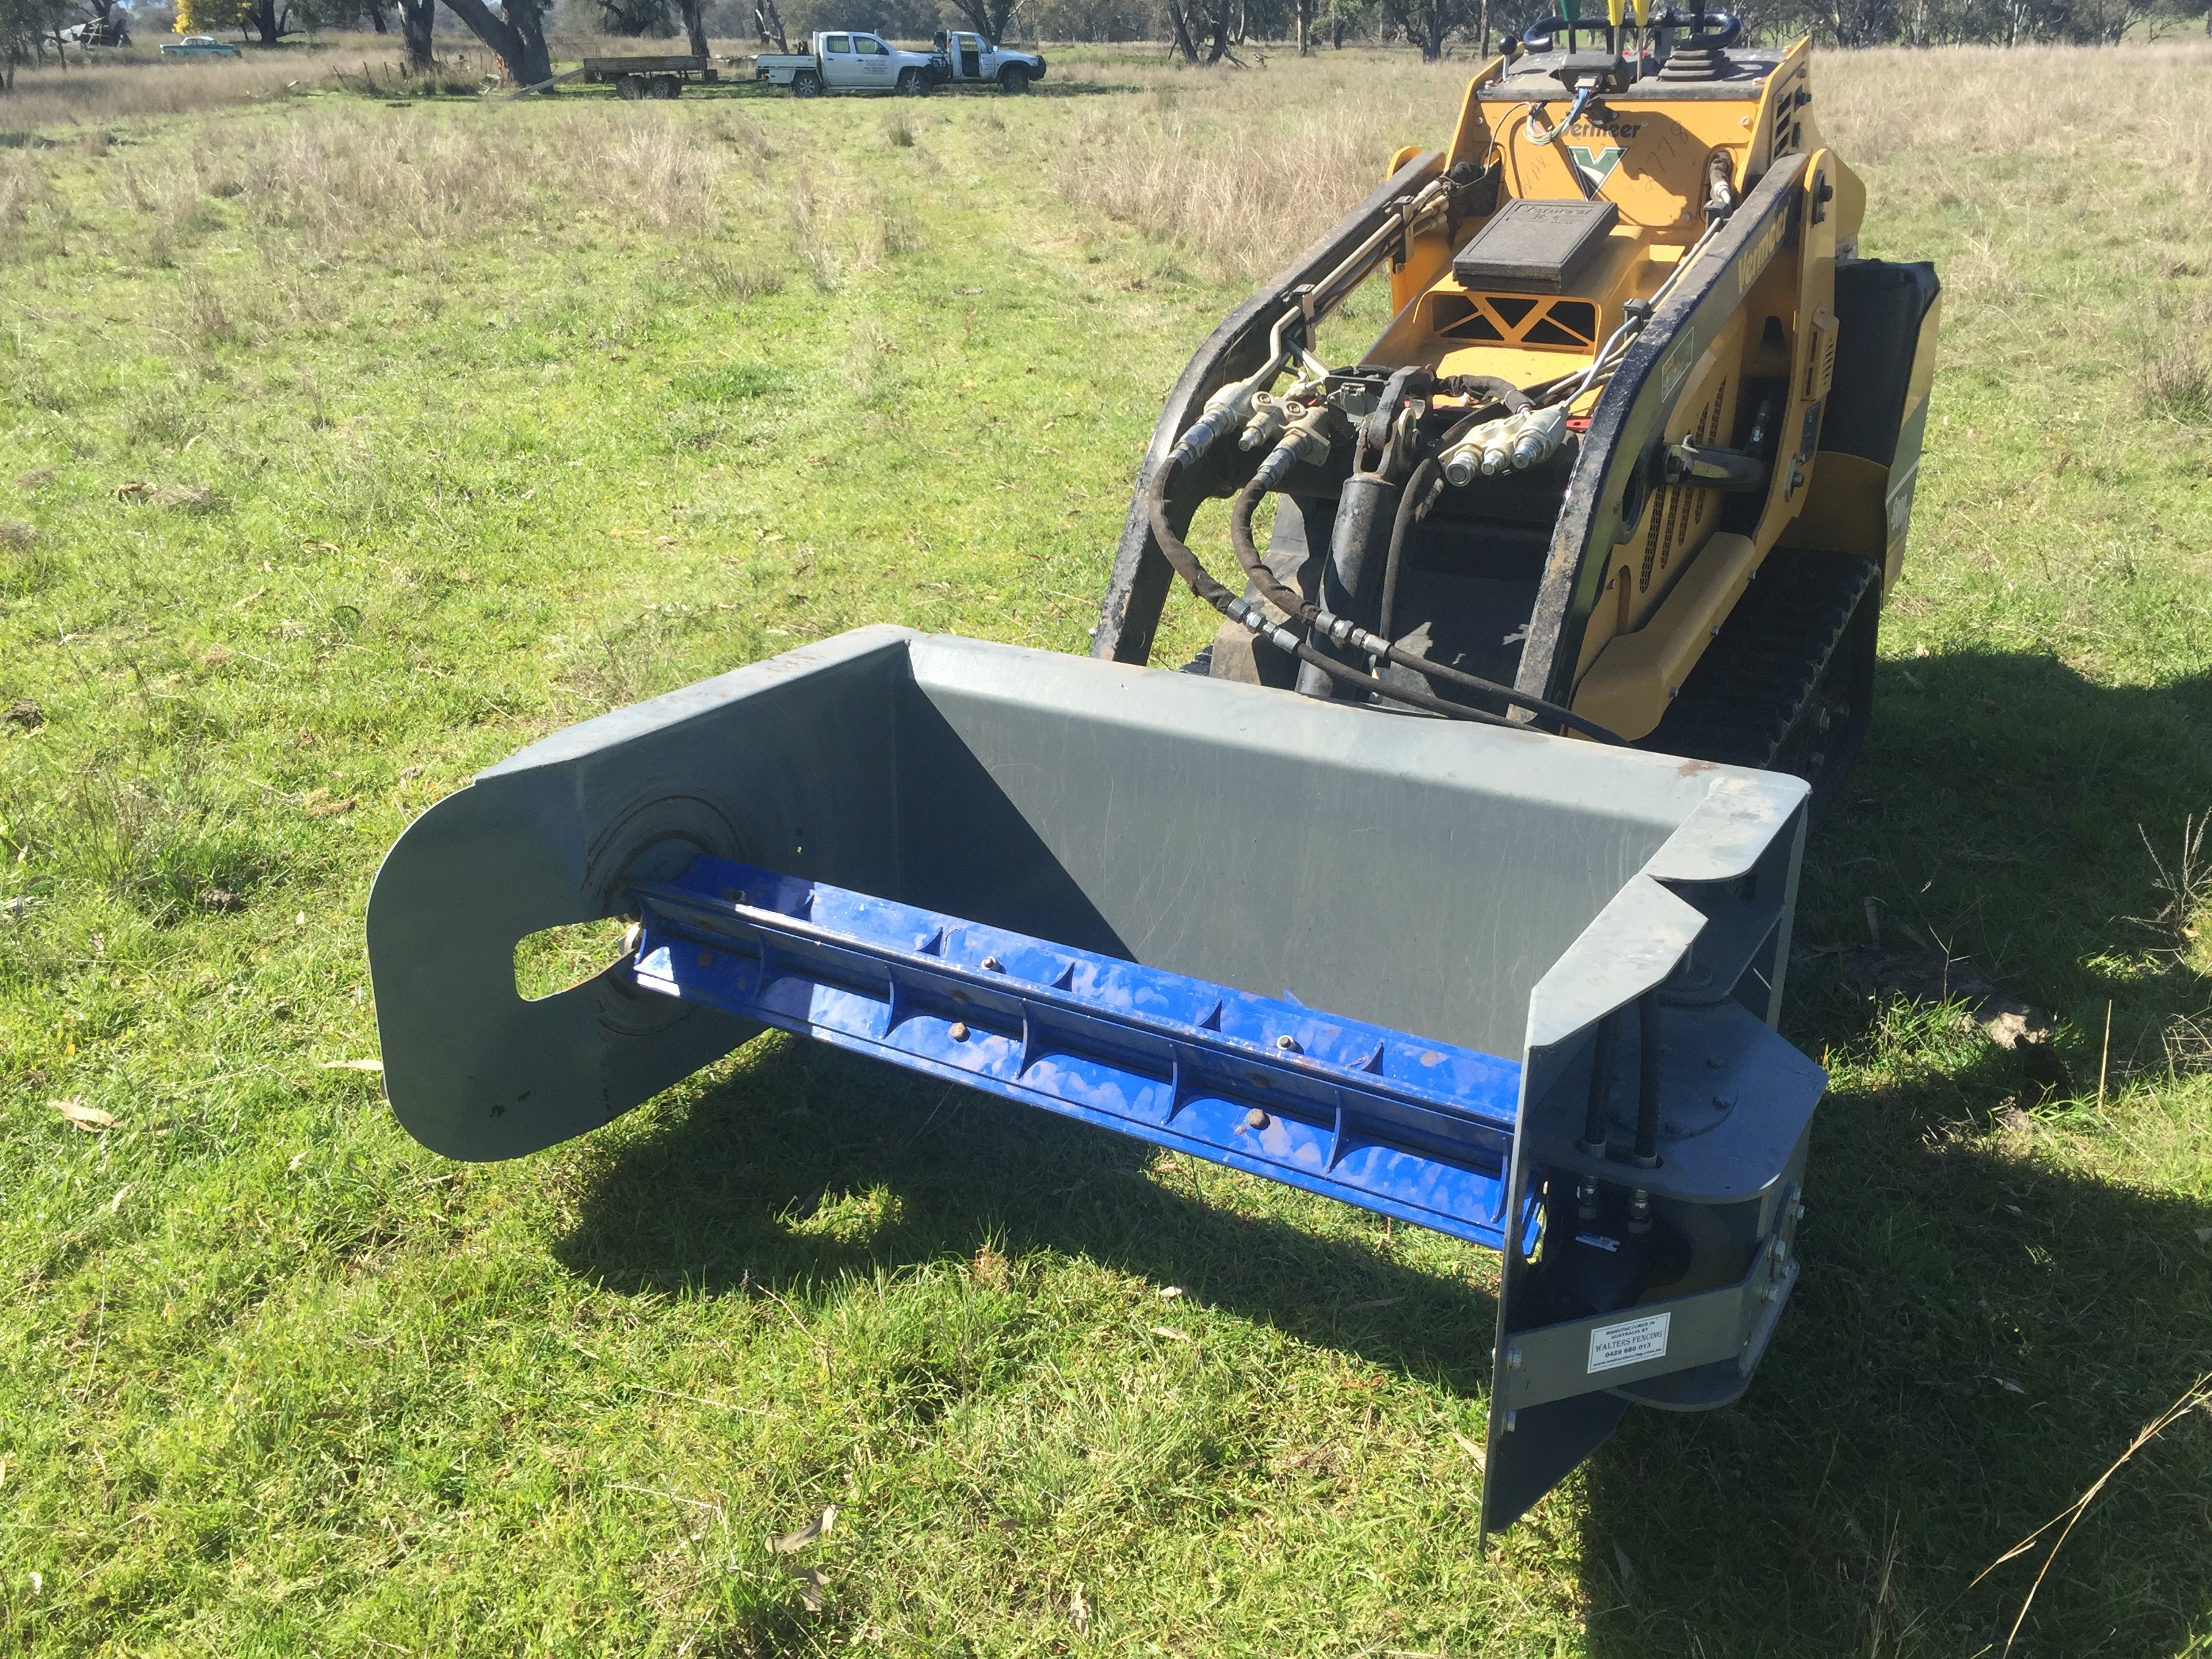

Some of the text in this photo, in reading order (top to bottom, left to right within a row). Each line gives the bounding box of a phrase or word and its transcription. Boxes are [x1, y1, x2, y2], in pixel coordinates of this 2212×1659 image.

[1738, 203, 1789, 295] Vermeer
[1606, 1323, 1648, 1335] MANUFACTURED
[1611, 1330, 1640, 1340] AUSTRALIA
[1596, 1331, 1662, 1351] WALTERS FENCING
